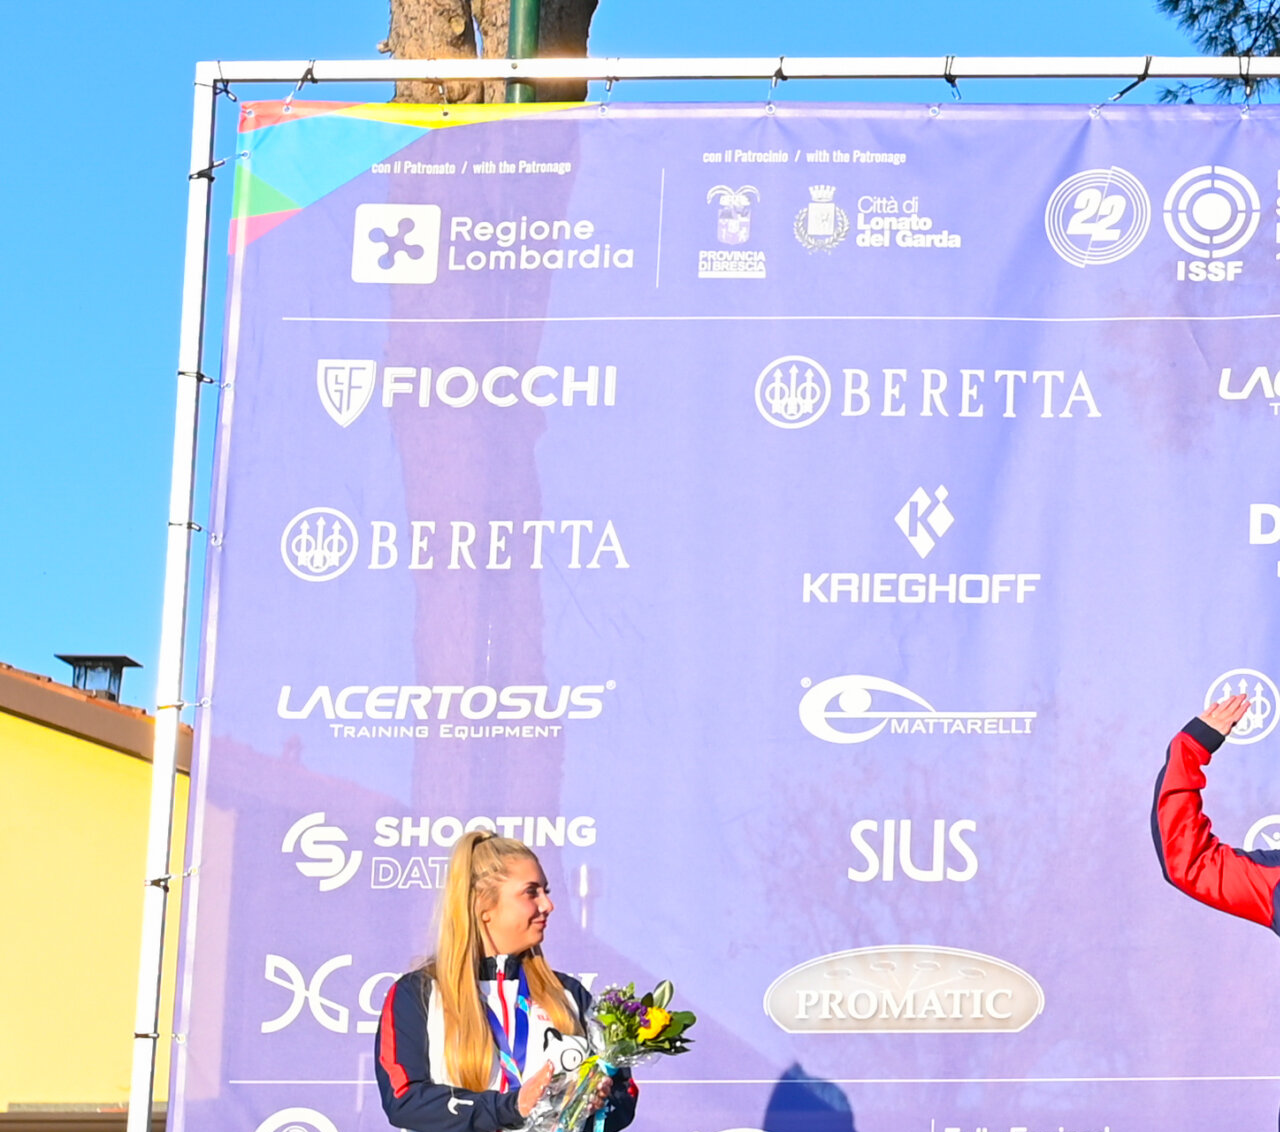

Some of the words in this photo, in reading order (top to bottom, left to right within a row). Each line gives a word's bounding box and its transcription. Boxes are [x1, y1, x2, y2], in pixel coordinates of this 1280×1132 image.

[372, 162, 390, 173] con
[394, 162, 401, 173] il
[404, 161, 455, 174] Patronato
[473, 161, 496, 174] with
[500, 161, 515, 173] the
[519, 161, 571, 175] Patronage
[703, 151, 723, 163] con
[725, 151, 731, 163] il
[735, 151, 788, 163] Patrocinio
[807, 151, 830, 163] with
[833, 151, 849, 163] the
[853, 151, 906, 165] Patronage
[857, 196, 898, 214] Città
[903, 196, 919, 213] di
[450, 216, 594, 247] Regione
[857, 214, 932, 231] Lonato
[856, 231, 889, 248] del
[896, 231, 961, 248] Garda
[448, 244, 634, 270] Lombardia
[698, 261, 711, 271] DI
[713, 261, 765, 271] BRESCIA
[699, 251, 766, 261] PROVINCIA
[1177, 261, 1243, 282] ISSF
[381, 365, 617, 408] FIOCCHI
[841, 369, 1101, 418] BERETTA
[368, 519, 630, 570] BERETTA
[802, 572, 1041, 604] KRIEGHOFF
[277, 685, 605, 719] LACERTOSUS
[890, 717, 1033, 735] MATTARELLI
[847, 818, 978, 882] SIUS
[371, 858, 450, 889] DAT
[795, 989, 1013, 1020] PROMATIC
